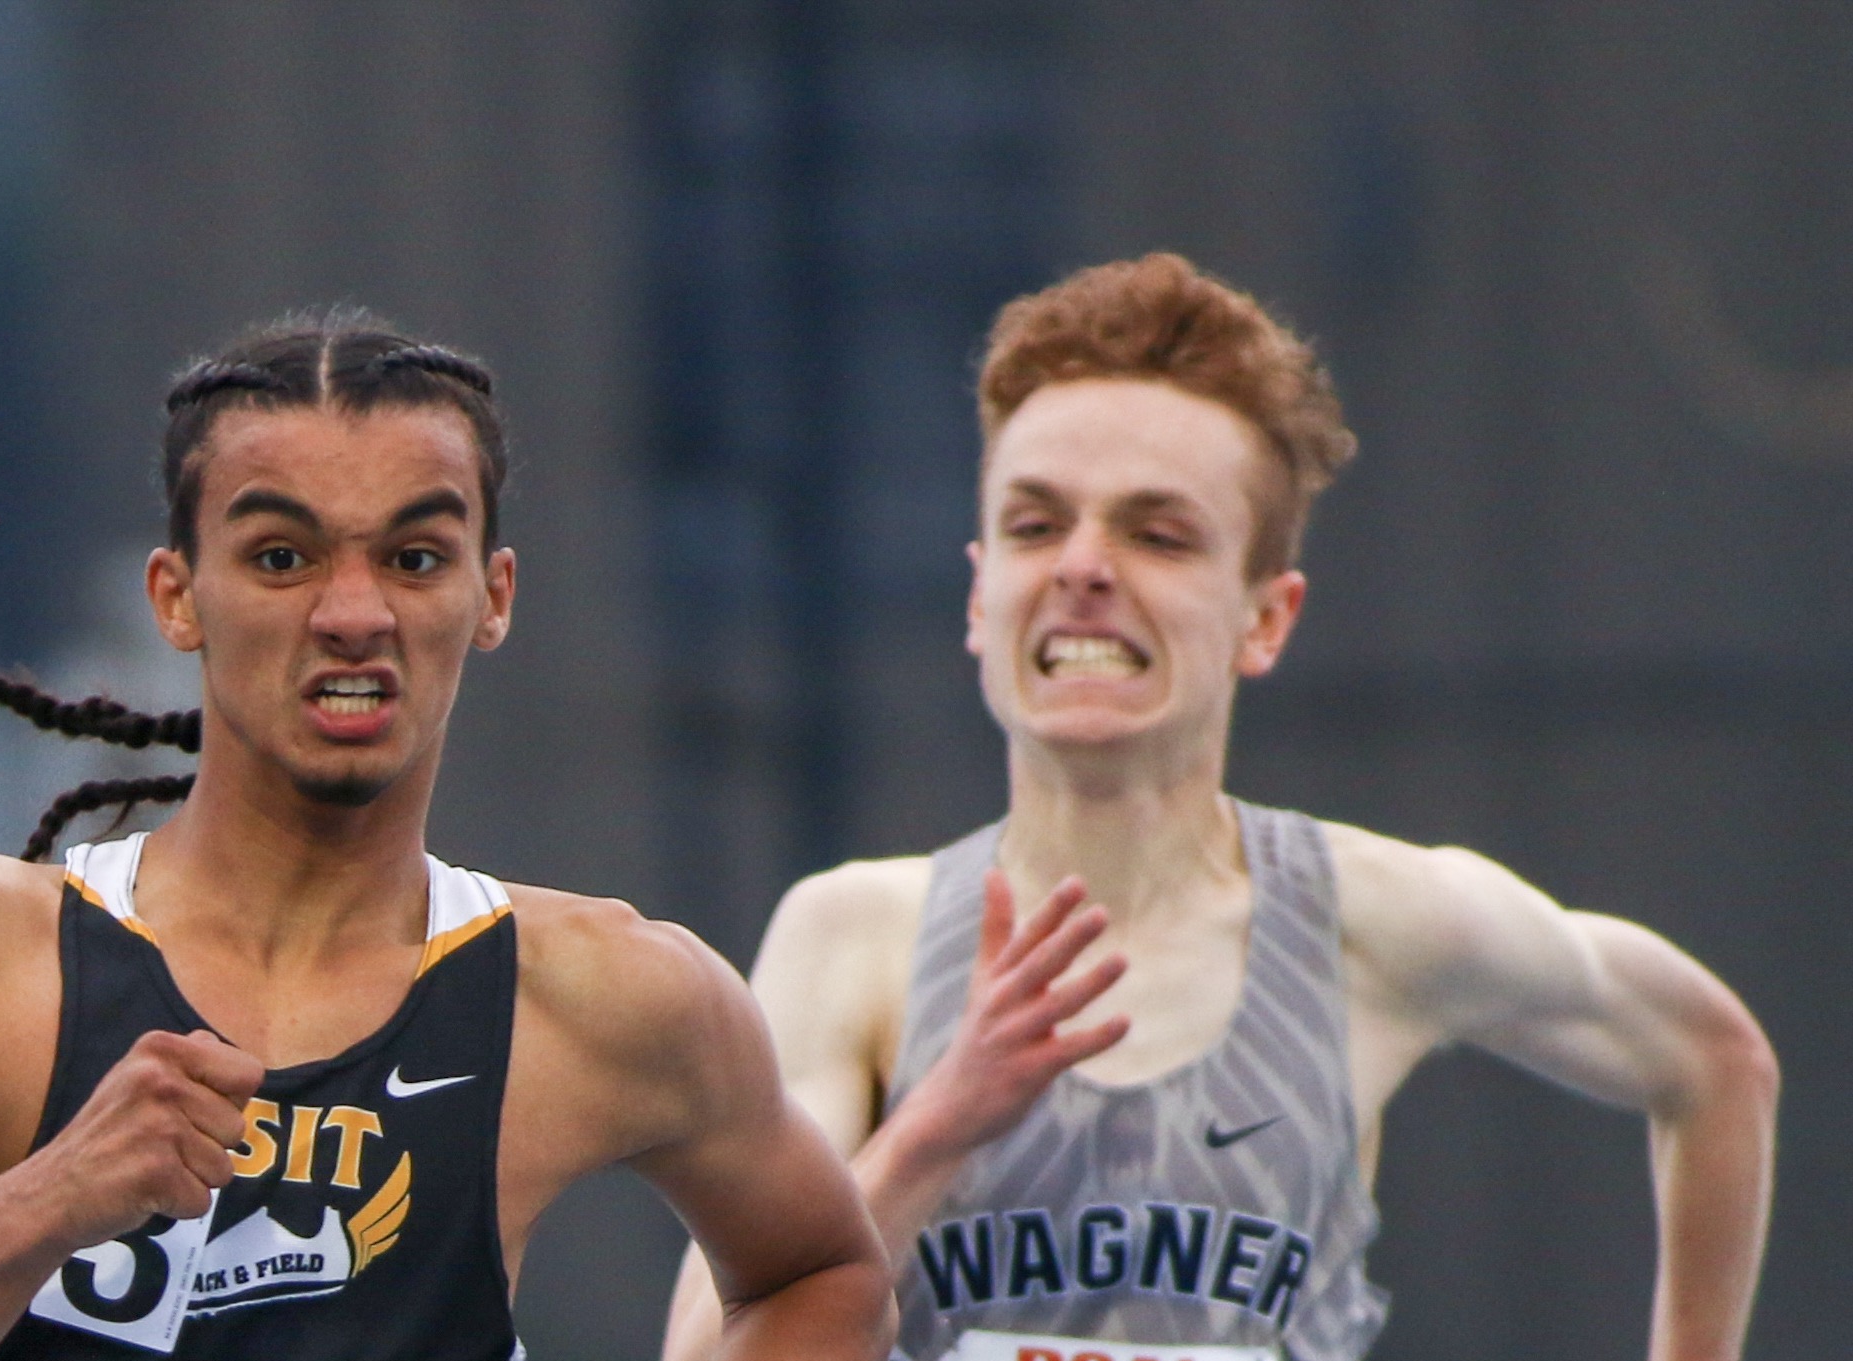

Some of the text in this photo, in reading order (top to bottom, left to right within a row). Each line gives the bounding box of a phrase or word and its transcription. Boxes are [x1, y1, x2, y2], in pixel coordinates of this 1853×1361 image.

[234, 1265, 250, 1285] &
[255, 1253, 324, 1279] FIELD
[915, 1203, 1313, 1329] WAGNER
